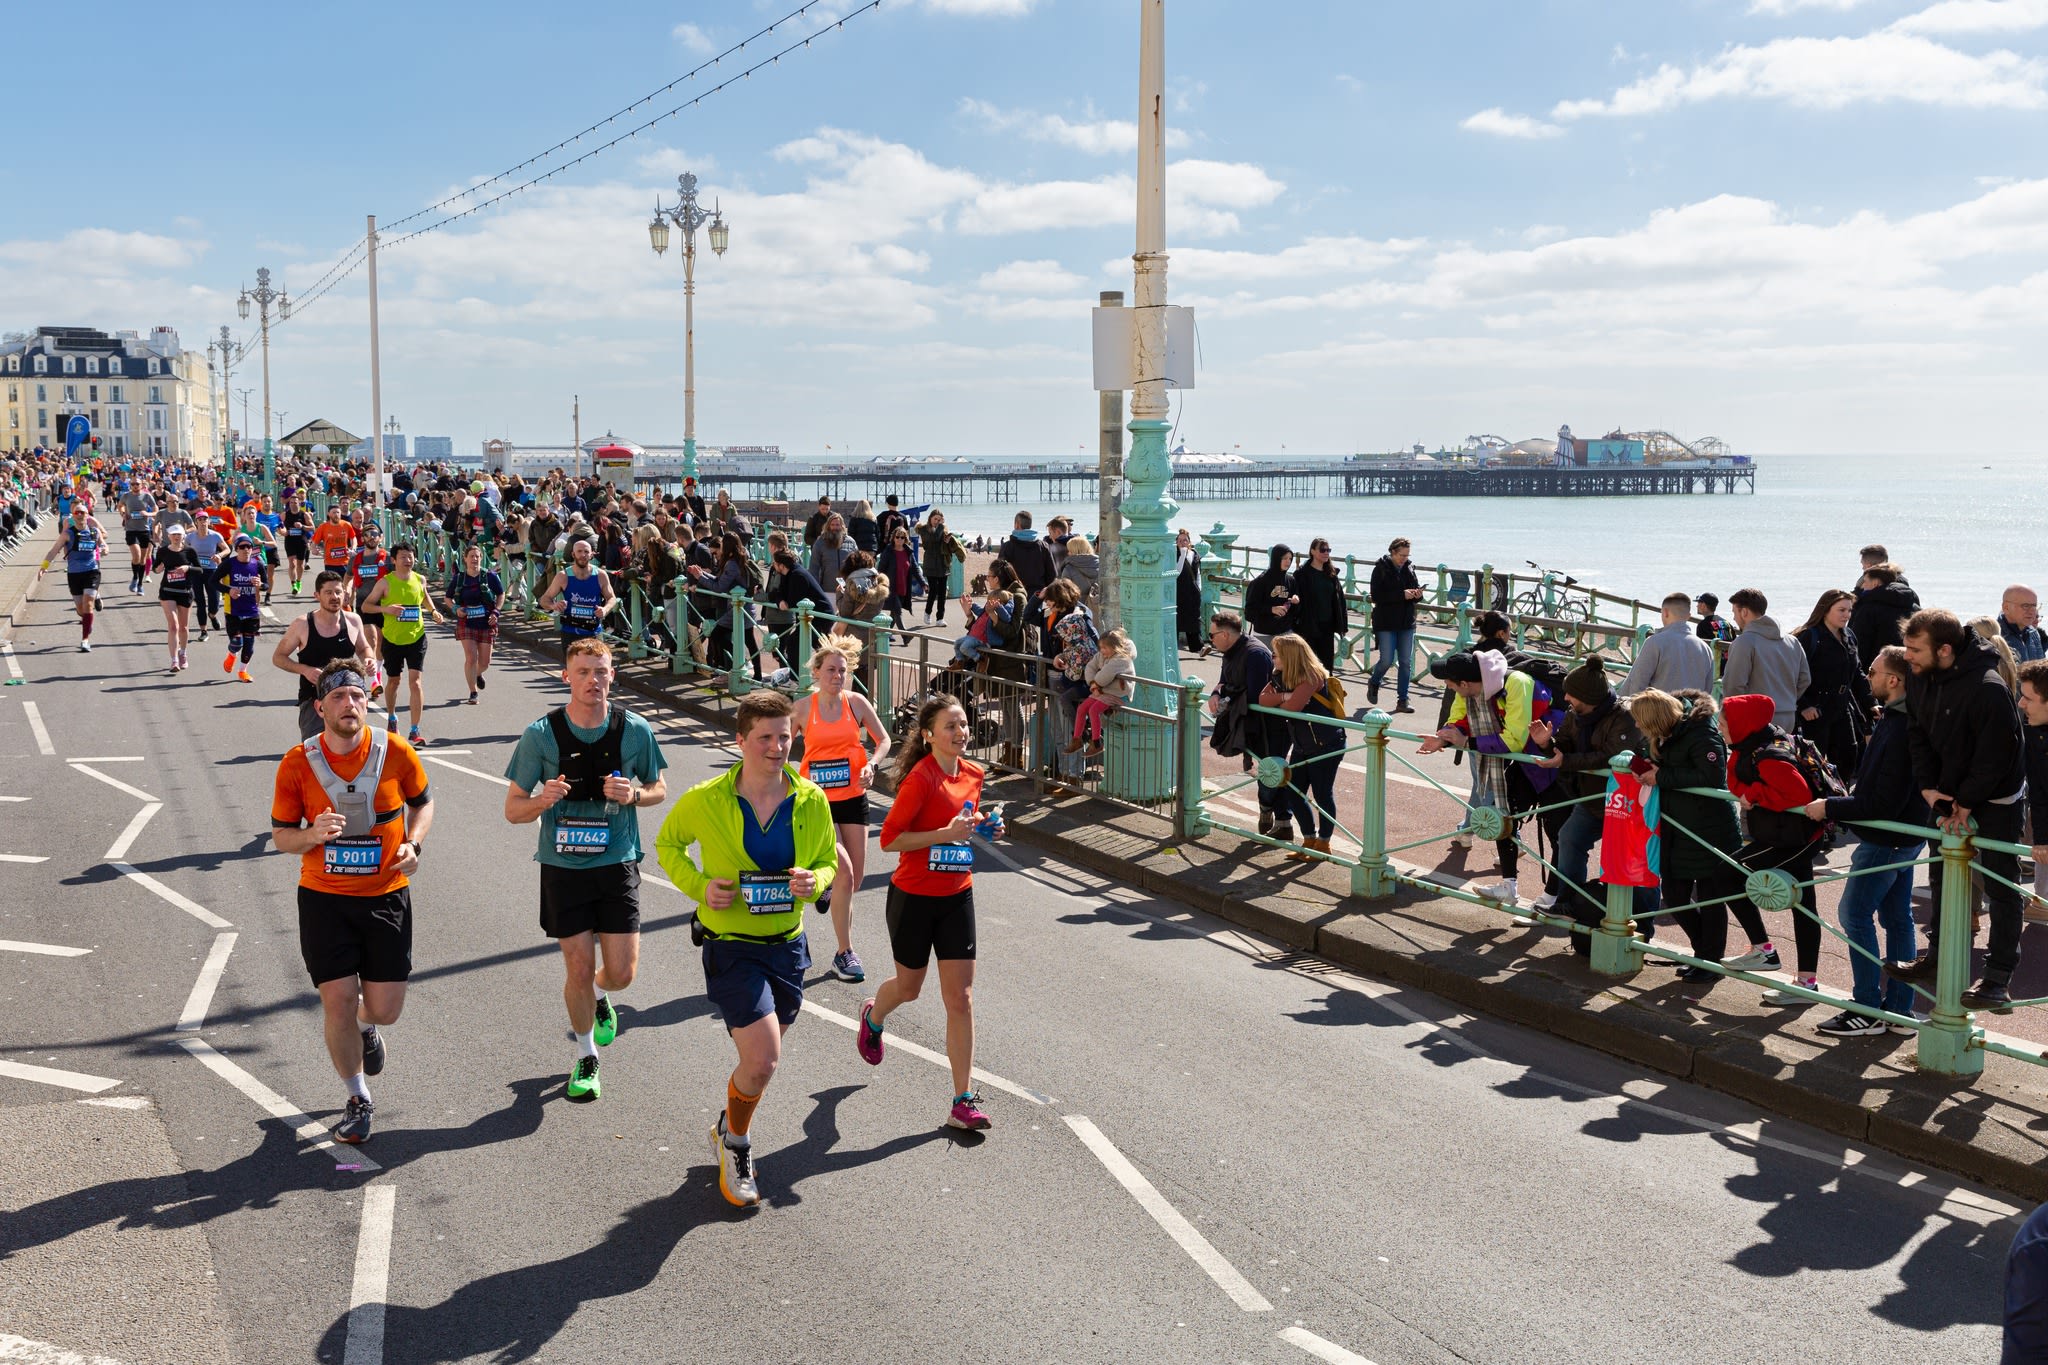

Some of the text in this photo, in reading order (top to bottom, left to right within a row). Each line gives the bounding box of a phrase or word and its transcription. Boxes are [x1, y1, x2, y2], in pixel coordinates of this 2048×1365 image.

[820, 769, 849, 781] 10995
[570, 831, 607, 843] 17642
[342, 851, 375, 863] 9011
[755, 887, 793, 901] 17843
